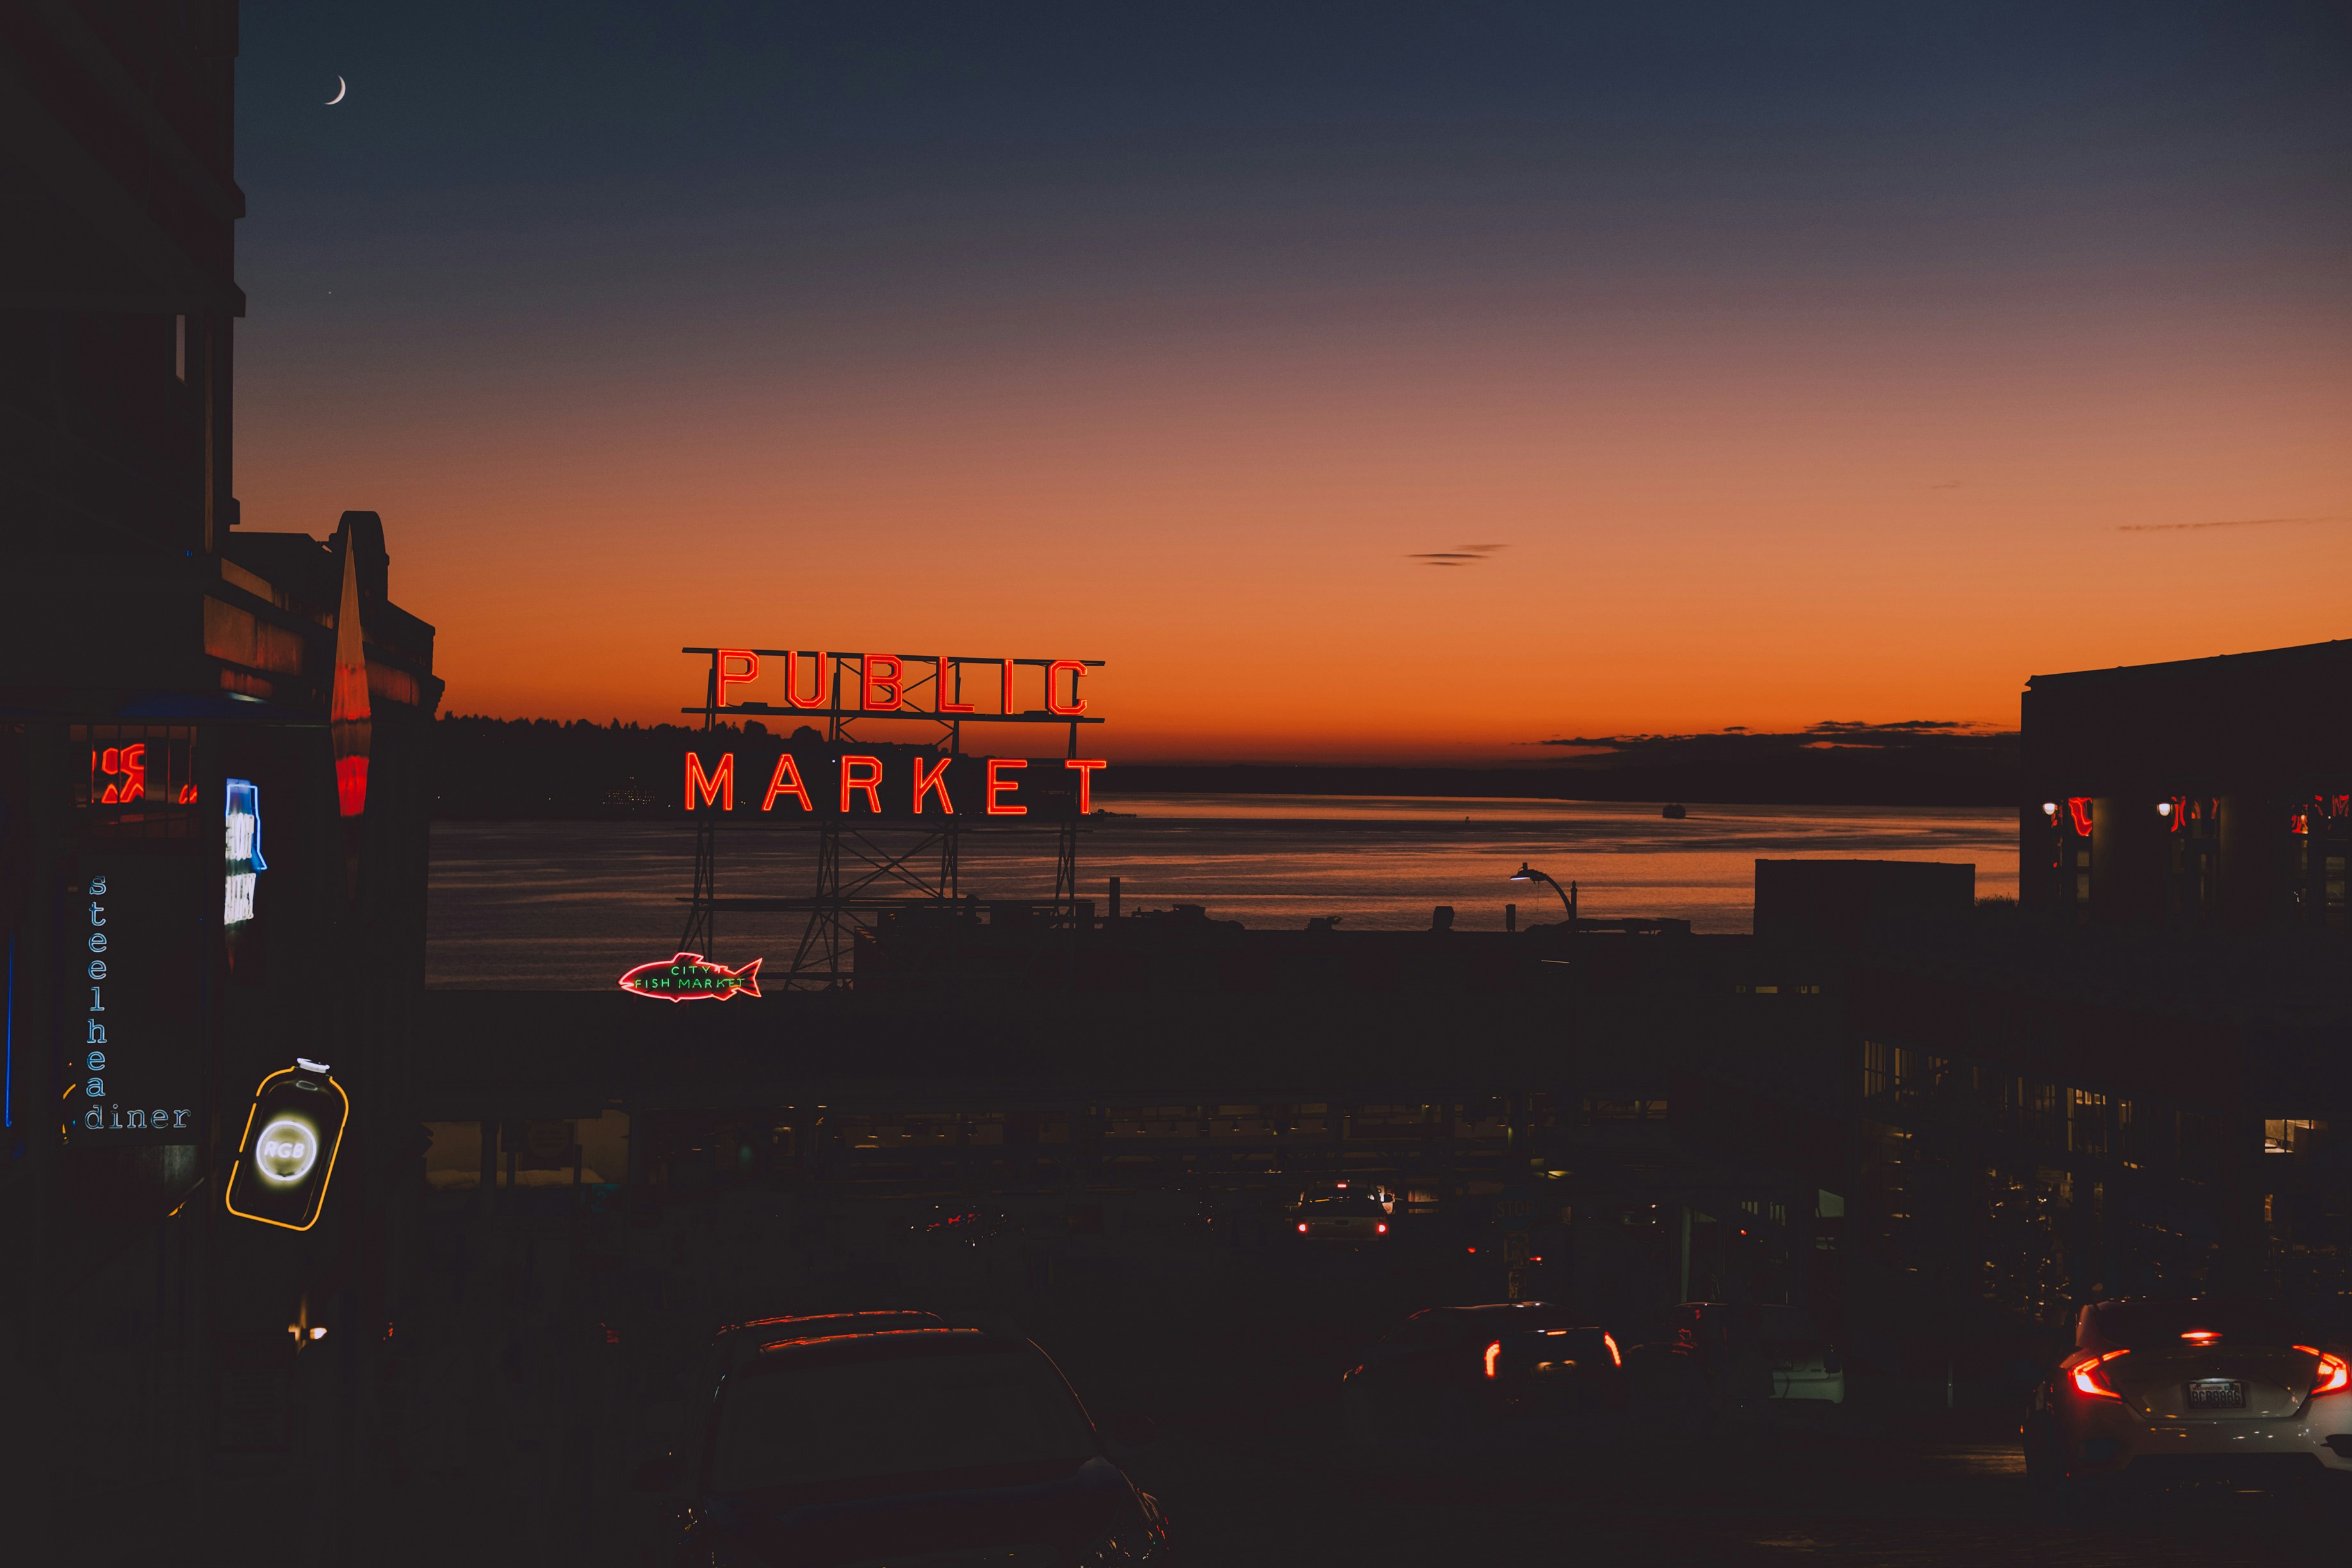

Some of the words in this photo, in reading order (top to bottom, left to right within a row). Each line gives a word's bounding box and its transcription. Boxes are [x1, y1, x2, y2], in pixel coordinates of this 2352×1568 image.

[717, 649, 1088, 715] PUBLIC
[685, 752, 1107, 815] MARKET
[671, 966, 710, 976] CITY
[635, 978, 670, 988] FISH
[678, 978, 745, 988] MARKET
[85, 1104, 192, 1129] diner
[264, 1141, 306, 1158] RGB
[1496, 1200, 1535, 1218] STOP
